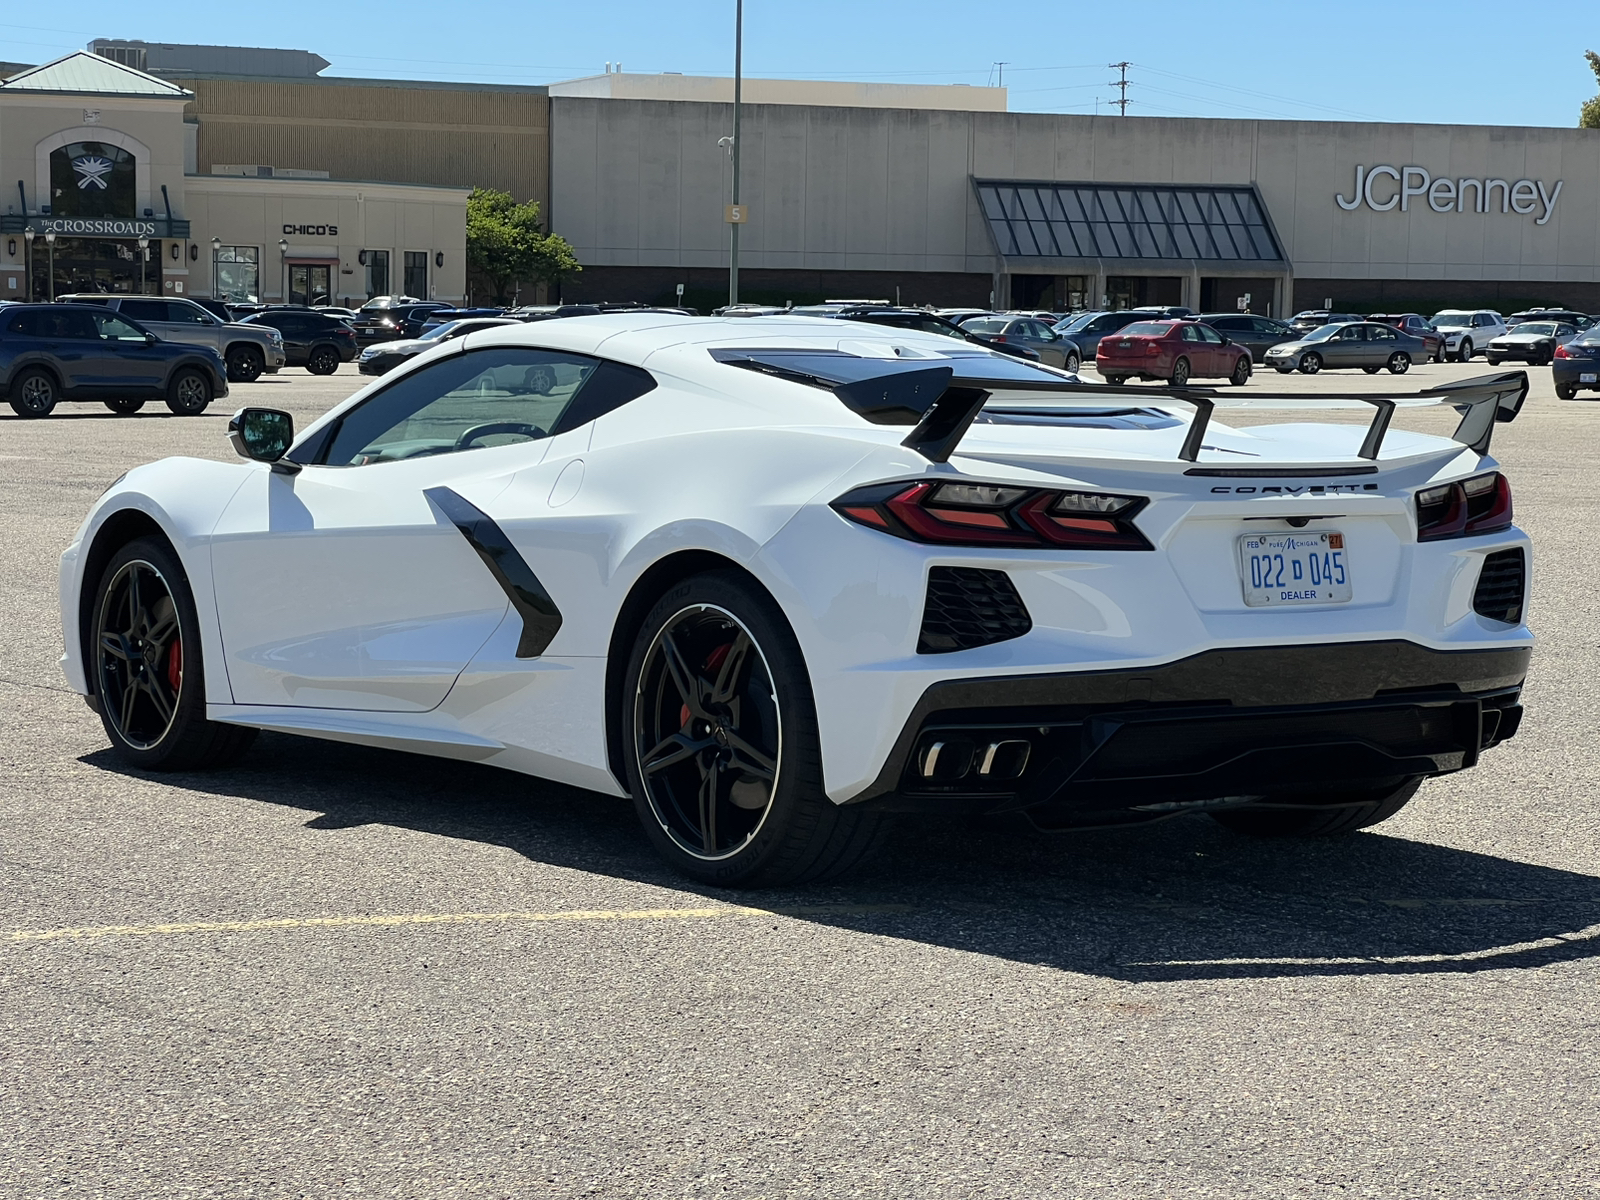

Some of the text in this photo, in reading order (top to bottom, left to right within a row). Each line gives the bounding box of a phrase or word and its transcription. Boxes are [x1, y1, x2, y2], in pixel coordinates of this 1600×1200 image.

[1335, 164, 1564, 226] JCPenney
[731, 207, 741, 220] 5
[41, 219, 155, 235] The CROSSROADS
[282, 223, 338, 236] CHICO'S
[1210, 483, 1379, 494] CORVETTE
[1246, 540, 1260, 549] FEB
[1281, 537, 1318, 552] MICHIGAN
[1329, 535, 1339, 545] 27
[1250, 551, 1345, 589] 022 D 045
[1280, 590, 1317, 601] DEALER
